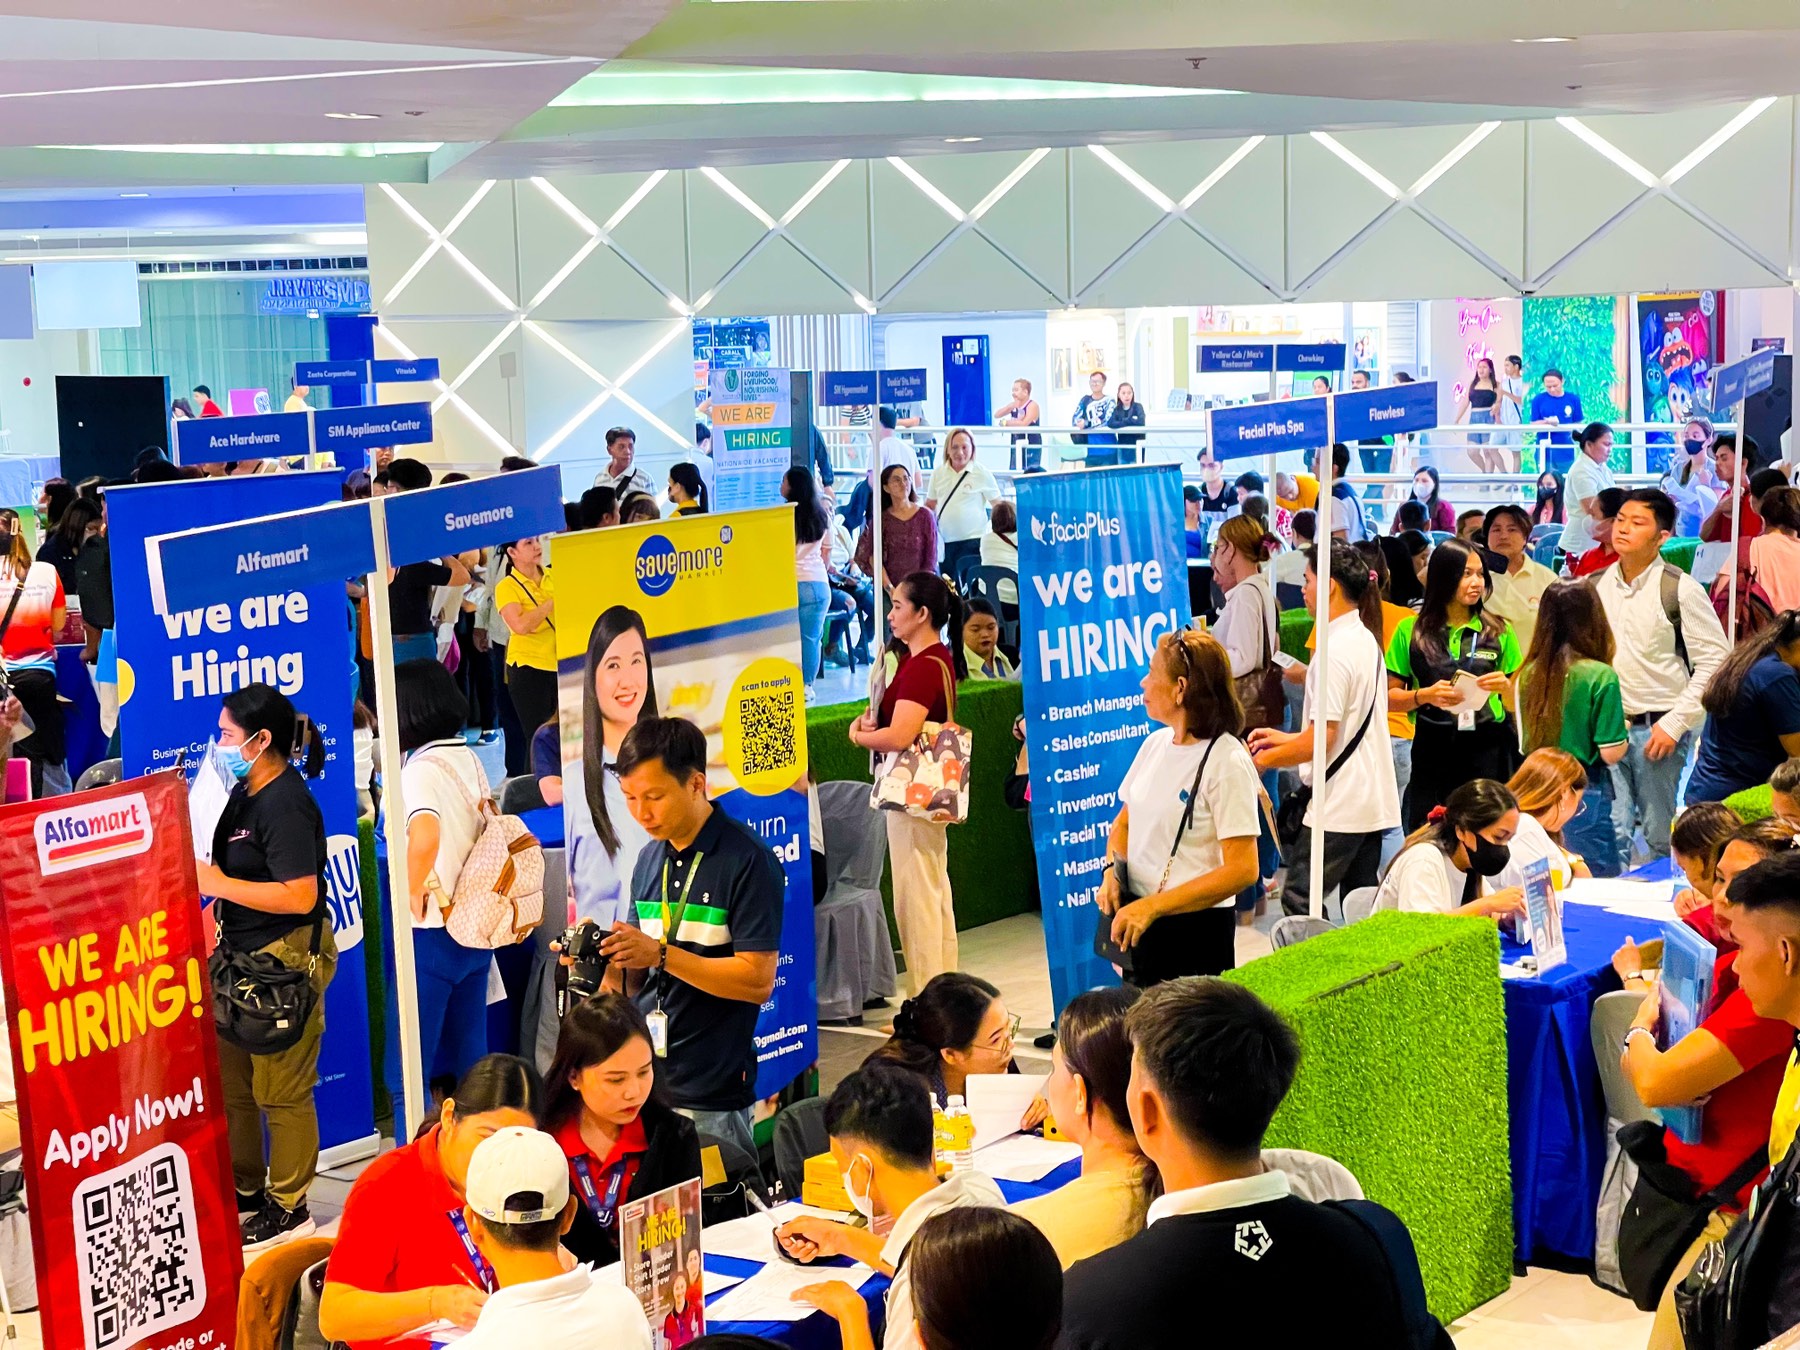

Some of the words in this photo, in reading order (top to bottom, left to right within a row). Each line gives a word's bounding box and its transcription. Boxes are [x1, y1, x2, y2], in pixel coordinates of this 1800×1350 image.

[1211, 351, 1231, 359] Yellow
[1231, 350, 1243, 359] Cab
[1221, 359, 1253, 368] Restaurant
[1298, 354, 1325, 363] Chowking
[324, 370, 357, 379] Corporation
[720, 408, 741, 421] WE
[745, 406, 772, 420] ARE
[1369, 405, 1406, 422] Flawless
[328, 425, 345, 438] SM
[346, 422, 391, 438] Appliance
[391, 419, 421, 432] Center
[732, 431, 781, 447] HIRING
[1239, 424, 1267, 440] Facial
[1267, 422, 1286, 436] Plus
[1287, 420, 1305, 436] Spa
[209, 434, 229, 448] Ace
[230, 432, 281, 447] Hardware
[444, 505, 514, 531] Savemore
[236, 544, 310, 574] Alfamart
[636, 546, 723, 580] savemore
[679, 569, 723, 580] MARKET
[1032, 568, 1093, 608] we
[1103, 560, 1163, 599] are
[239, 590, 309, 629] are
[172, 645, 304, 701] Hiring
[741, 683, 760, 692] scan
[760, 680, 770, 688] to
[770, 675, 791, 689] apply
[1048, 699, 1093, 721] Branch
[1094, 693, 1144, 714] Manager
[1051, 734, 1088, 753] Sales
[1088, 721, 1150, 746] Consultant
[1054, 761, 1100, 784] Cashier
[1057, 791, 1116, 815] Inventory
[44, 804, 142, 845] Alfamart
[1060, 823, 1096, 846] Facial
[1066, 887, 1091, 908] Nail
[38, 933, 103, 992] WE
[114, 910, 169, 973] ARE
[17, 957, 204, 1074] HIRING!
[43, 1113, 130, 1170] Apply
[134, 1076, 205, 1135] Now!
[661, 1207, 677, 1222] ARE
[637, 1216, 687, 1253] HIRING!
[633, 1261, 651, 1273] Store
[199, 1329, 214, 1345] or
